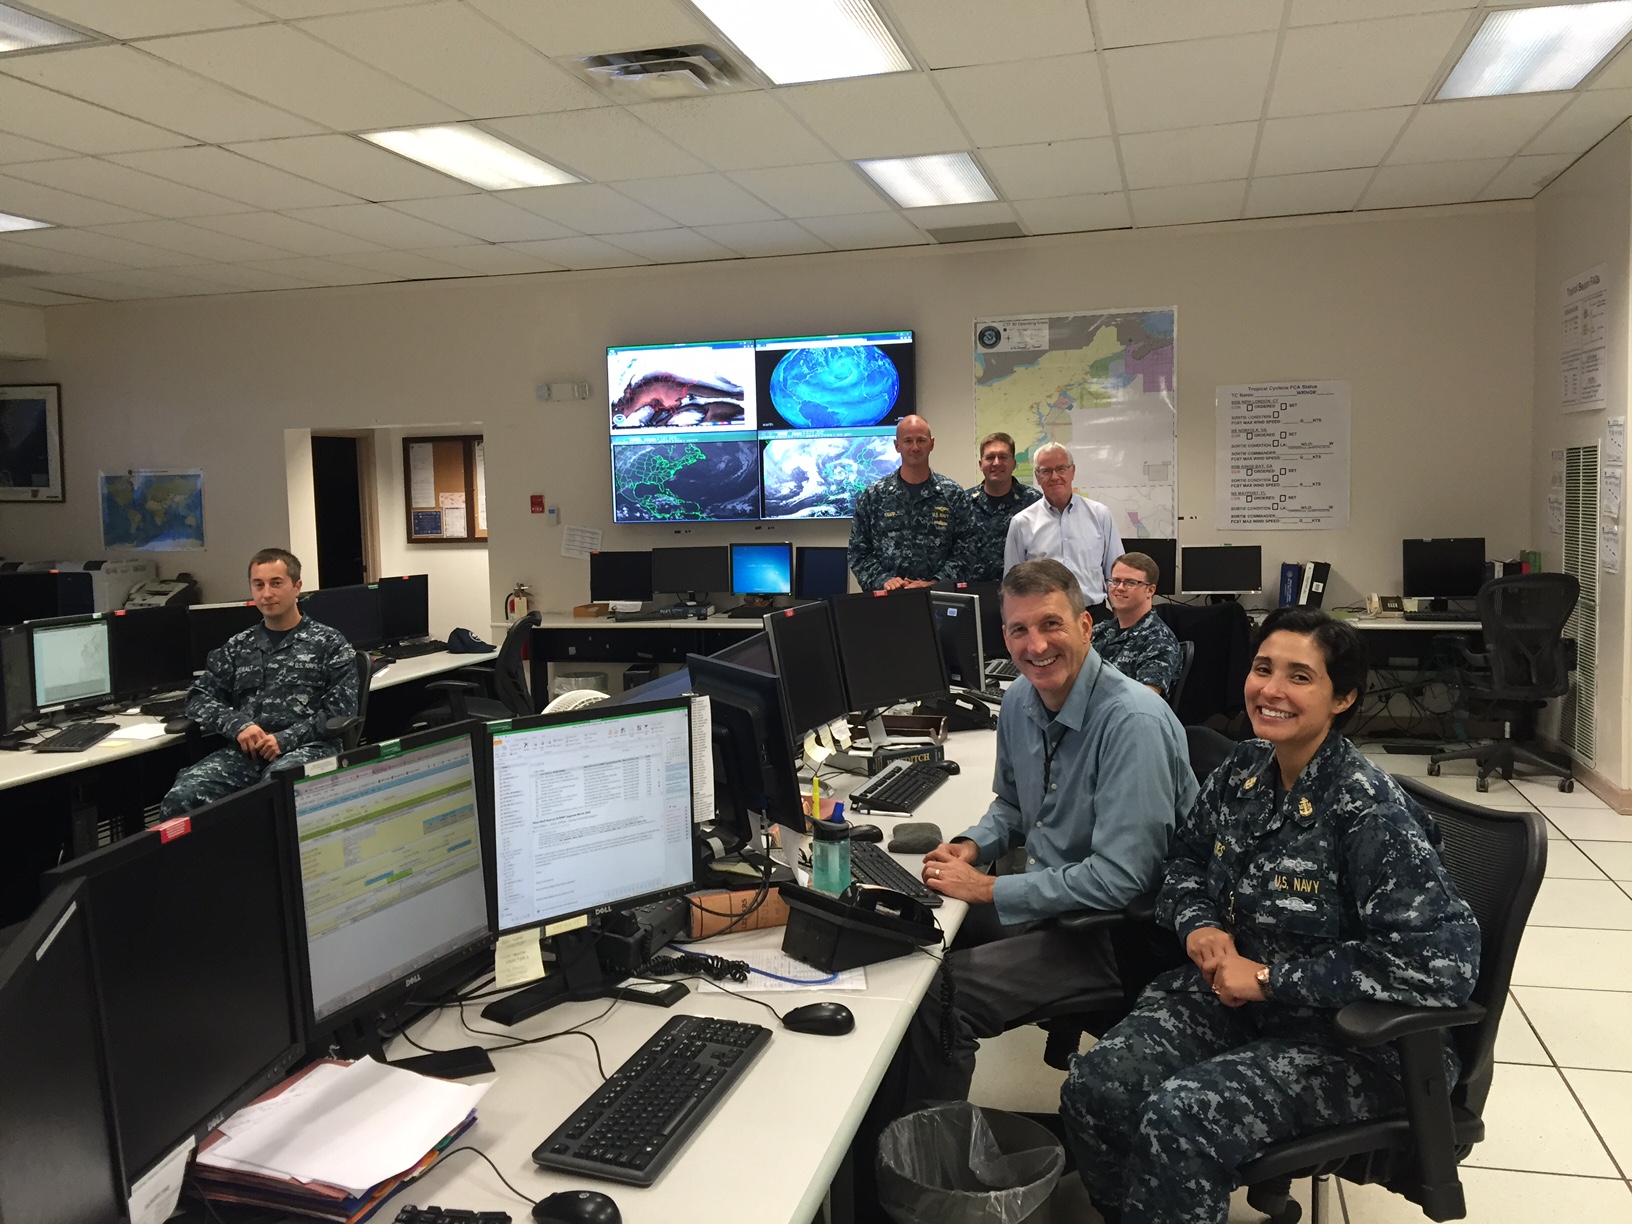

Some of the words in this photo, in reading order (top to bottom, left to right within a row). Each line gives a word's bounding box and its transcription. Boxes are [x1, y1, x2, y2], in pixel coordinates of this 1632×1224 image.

[887, 753, 931, 769] BDITCH
[1274, 874, 1289, 890] U.S.
[1293, 877, 1320, 894] NAVY
[595, 905, 613, 916] DELL
[405, 973, 421, 988] DELL
